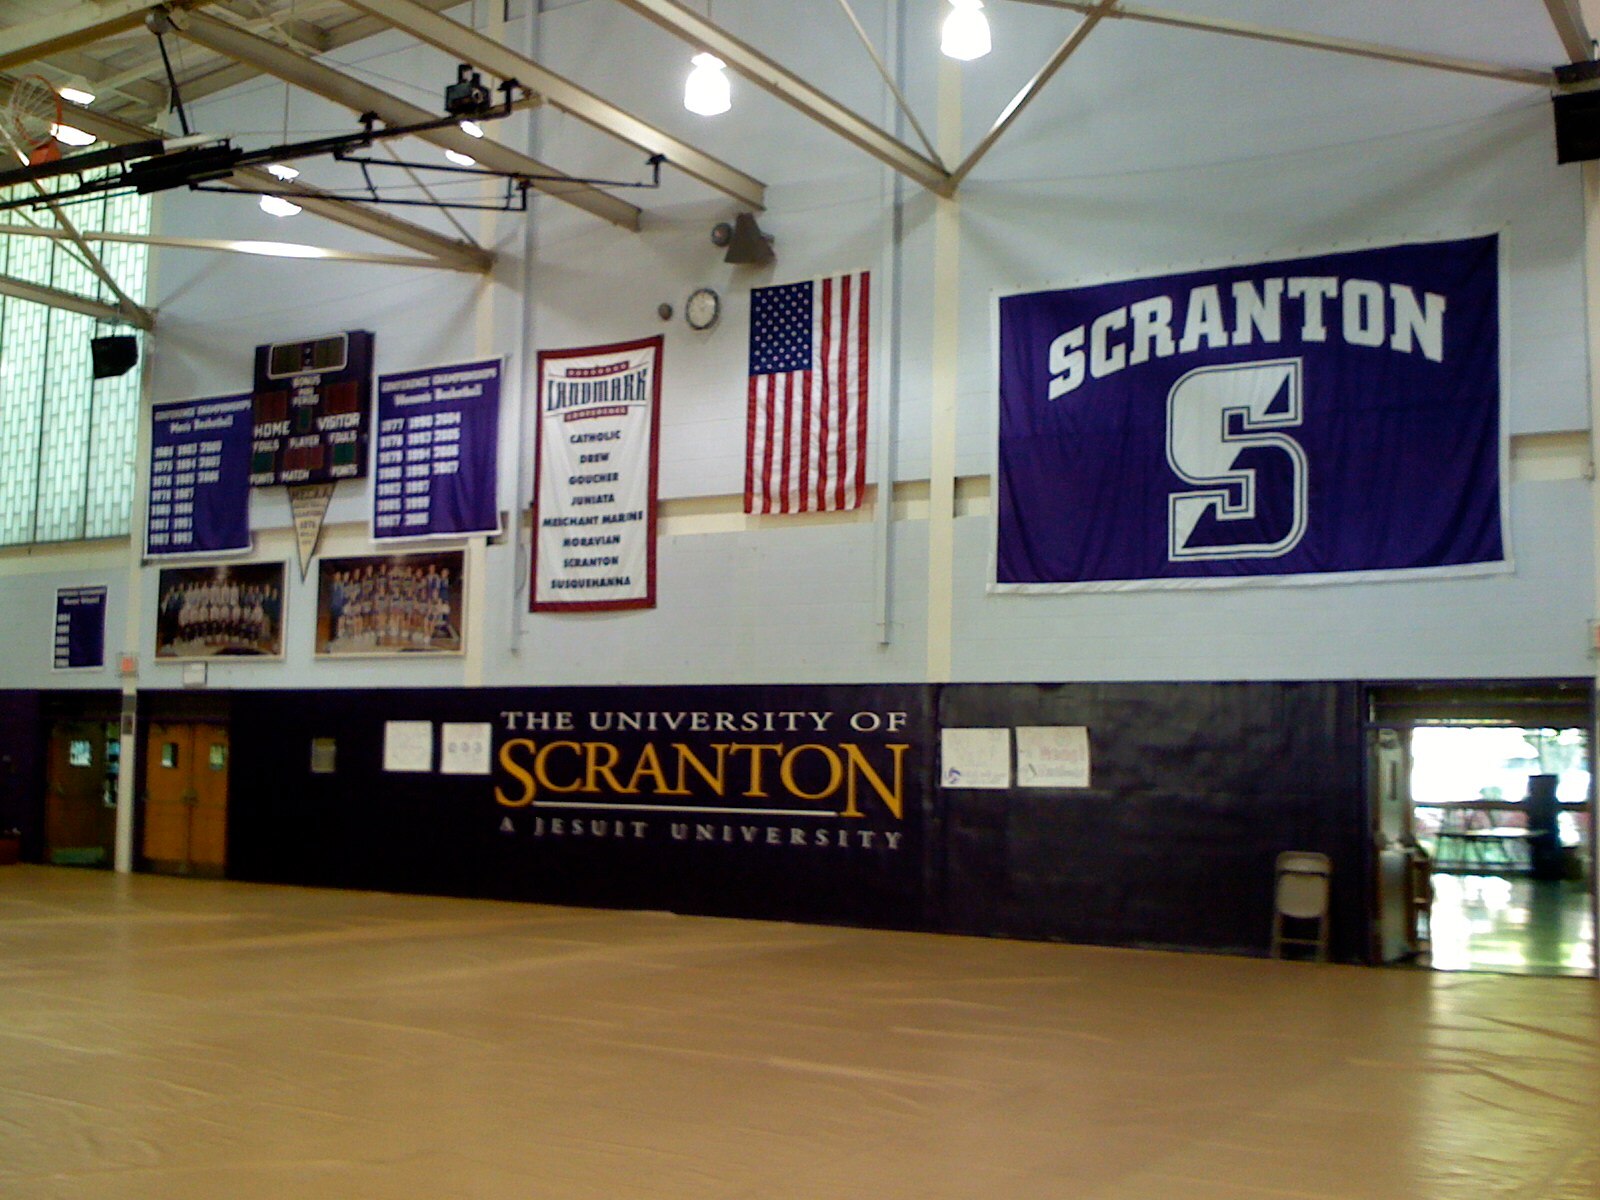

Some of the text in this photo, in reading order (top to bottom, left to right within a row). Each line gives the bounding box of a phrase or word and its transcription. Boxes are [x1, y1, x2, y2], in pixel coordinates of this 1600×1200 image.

[1048, 276, 1446, 400] SCRANTON
[547, 368, 648, 411] LANDMARK
[254, 420, 291, 438] HOME
[316, 412, 360, 431] VISITOR
[569, 430, 621, 444] CATHOLIC
[580, 452, 611, 464] DREW
[1166, 356, 1308, 561] S
[568, 472, 619, 485] GOUCHER
[571, 494, 615, 506] JUNIATA
[542, 511, 643, 527] MERCHANT MARINE
[563, 535, 620, 547] MORAVIAN
[563, 556, 619, 568] SCRANTON
[551, 576, 631, 589] SUSQUEHANNA
[500, 711, 908, 732] THE UNIVERSITY OF
[494, 738, 910, 820] SCRANTON
[499, 816, 903, 849] A JESUIT UNIVERSITY
